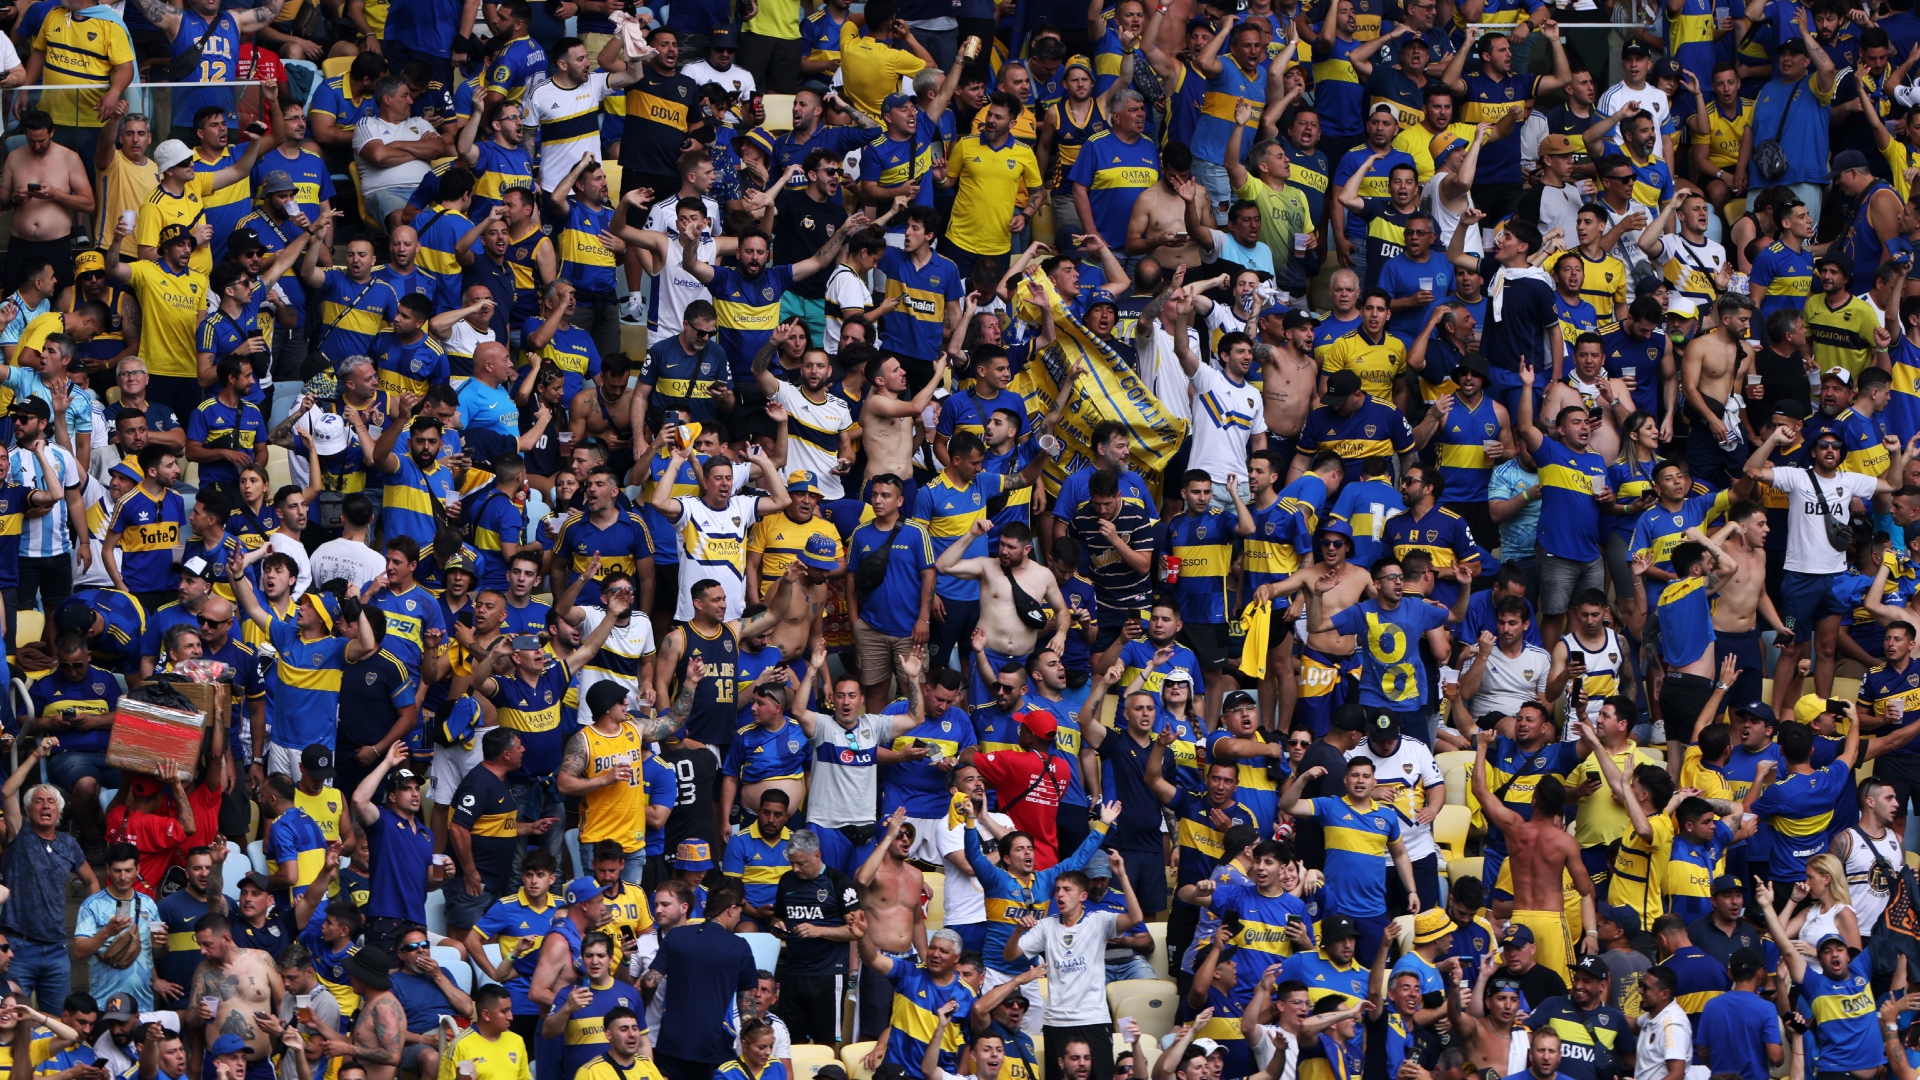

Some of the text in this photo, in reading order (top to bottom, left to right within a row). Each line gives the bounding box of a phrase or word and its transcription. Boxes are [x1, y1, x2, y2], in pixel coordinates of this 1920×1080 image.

[50, 50, 90, 69] betsson
[200, 61, 227, 82] 12
[651, 105, 680, 124] BBVA
[1121, 170, 1151, 182] QATAR
[1300, 170, 1329, 187] QATAR
[1271, 206, 1303, 226] BBVA
[273, 227, 287, 242] adidas
[163, 292, 195, 307] QATAR
[733, 314, 774, 323] betsson
[1359, 370, 1392, 381] QATAR
[320, 414, 336, 424] 12
[707, 542, 741, 554] QATAR
[719, 663, 734, 679] JRS
[715, 679, 733, 704] 12
[524, 711, 556, 726] QATAR
[855, 754, 870, 763] LG
[457, 805, 473, 816] TOTAL
[624, 903, 638, 919] 10
[785, 905, 825, 921] BBVA
[1242, 926, 1286, 945] Quilme
[1053, 956, 1086, 970] QATAR
[1841, 993, 1873, 1014] BBVA
